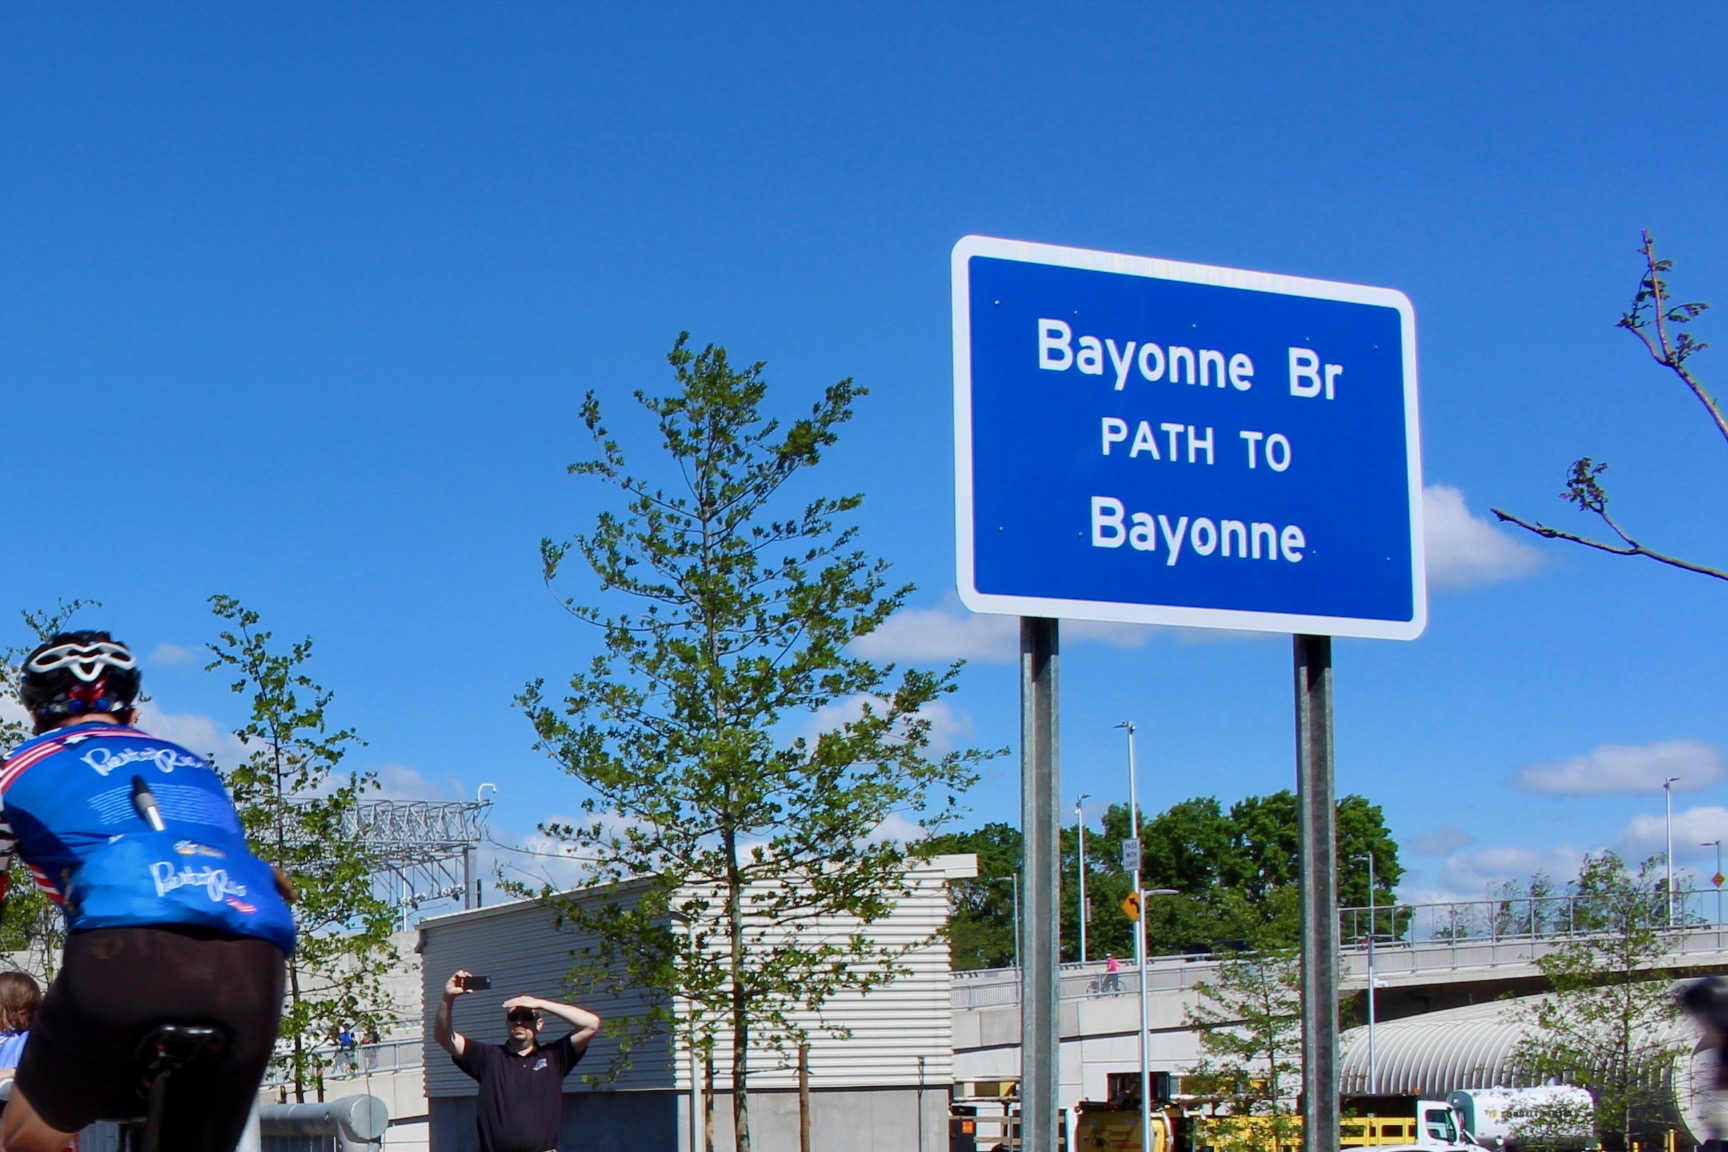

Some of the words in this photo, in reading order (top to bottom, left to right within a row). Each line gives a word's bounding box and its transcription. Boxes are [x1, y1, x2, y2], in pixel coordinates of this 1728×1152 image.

[1038, 318, 1255, 390] Bayonne
[1288, 347, 1343, 400] Br
[1101, 417, 1215, 464] PATH
[1240, 430, 1292, 472] TO
[1090, 495, 1306, 566] Bayonne
